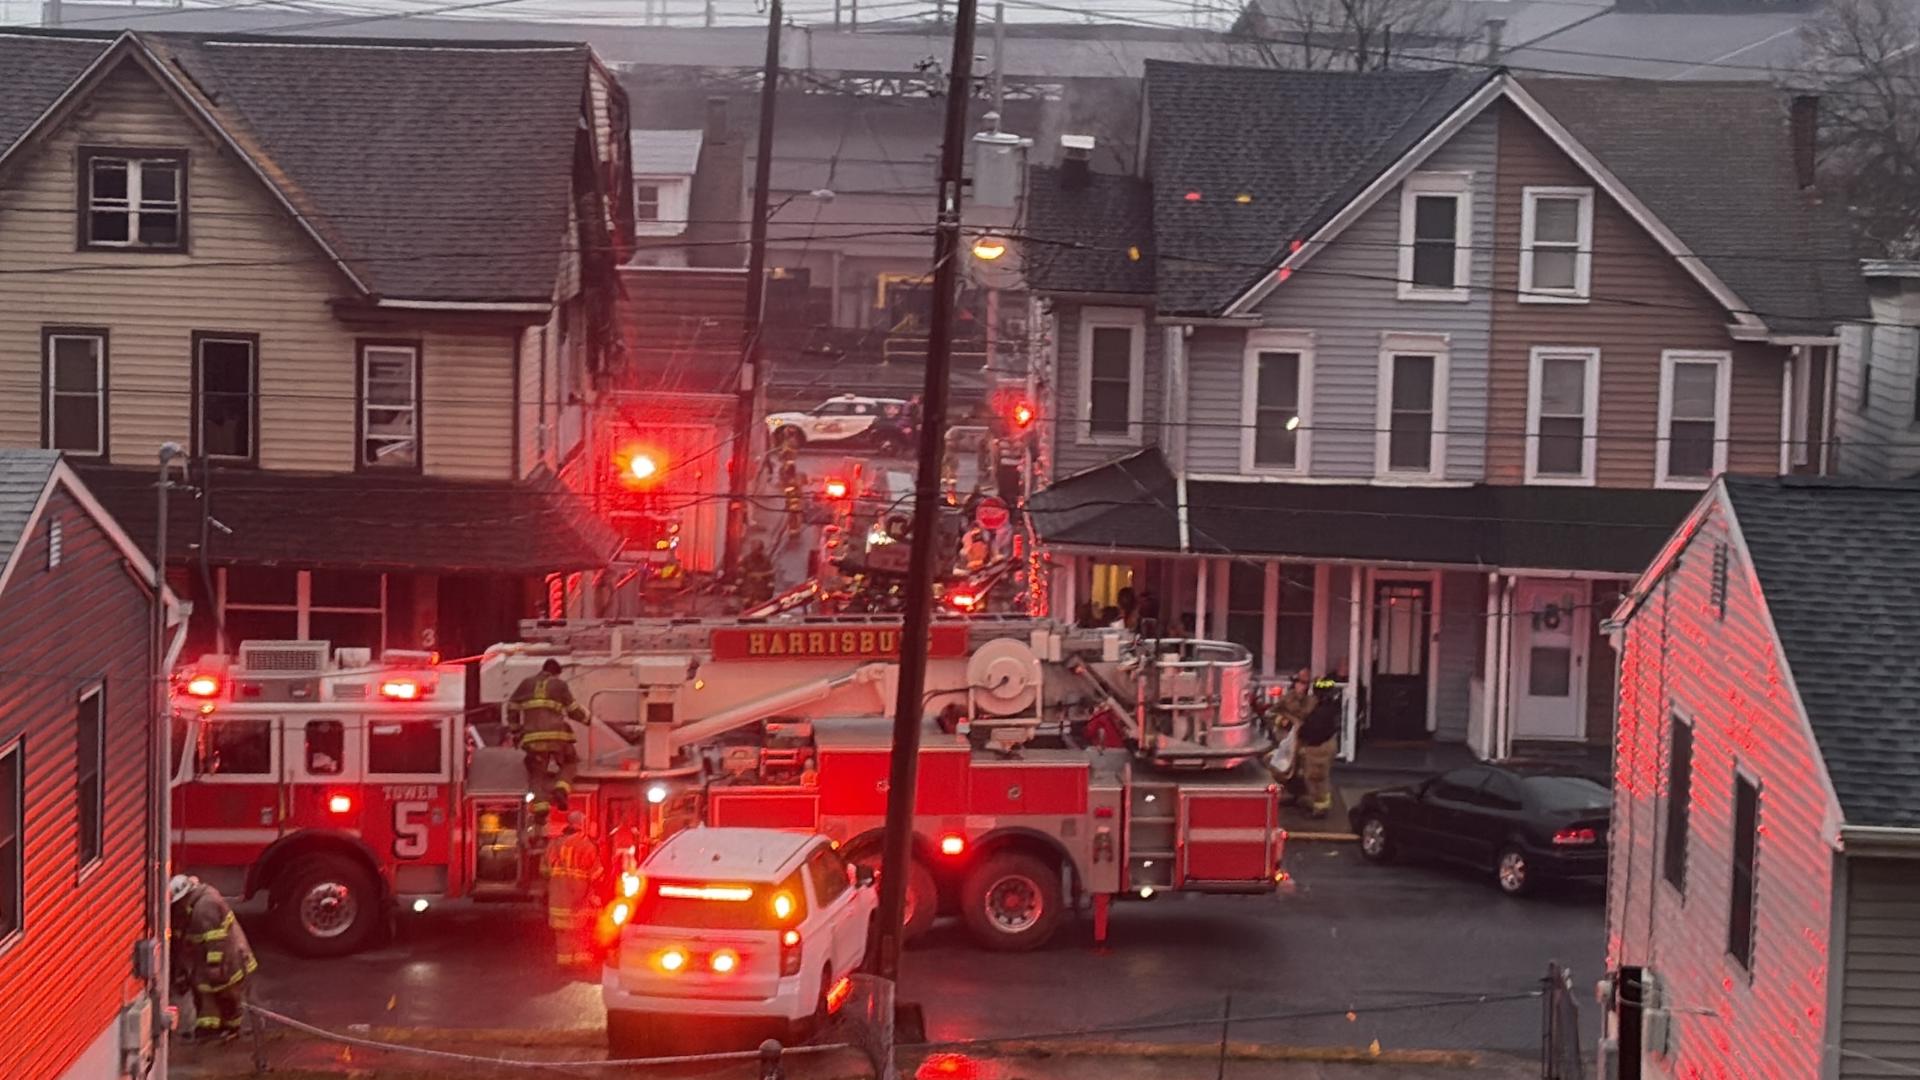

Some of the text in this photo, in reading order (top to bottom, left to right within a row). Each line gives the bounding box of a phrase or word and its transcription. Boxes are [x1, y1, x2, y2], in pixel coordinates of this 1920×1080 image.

[749, 631, 933, 655] HARRISBU
[382, 785, 439, 800] TOWER
[394, 801, 429, 858] 5
